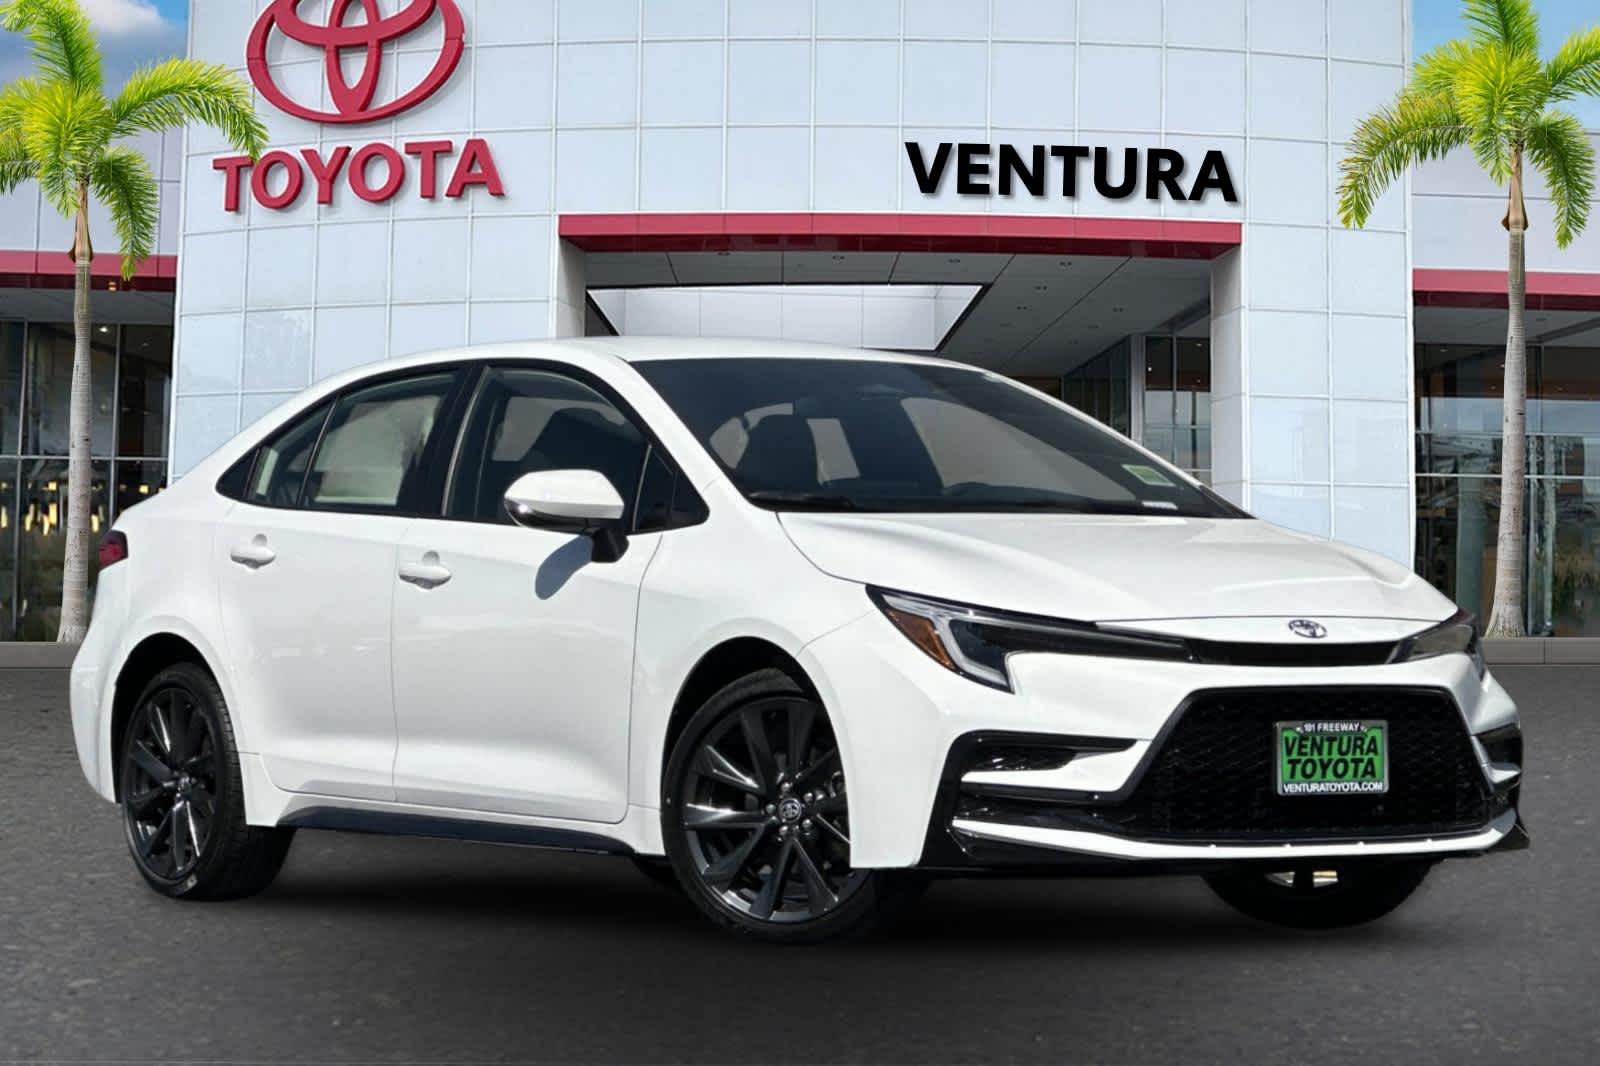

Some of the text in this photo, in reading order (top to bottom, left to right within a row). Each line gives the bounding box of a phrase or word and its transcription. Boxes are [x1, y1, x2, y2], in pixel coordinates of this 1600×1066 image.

[213, 138, 505, 212] TOYOTA
[904, 141, 1239, 203] VENTURA
[1317, 722, 1360, 732] FREEWAY
[1284, 735, 1379, 757] VENTURA
[1287, 757, 1377, 780] TOYOTA
[1283, 781, 1384, 793] VENTURATOYOTA.COM
